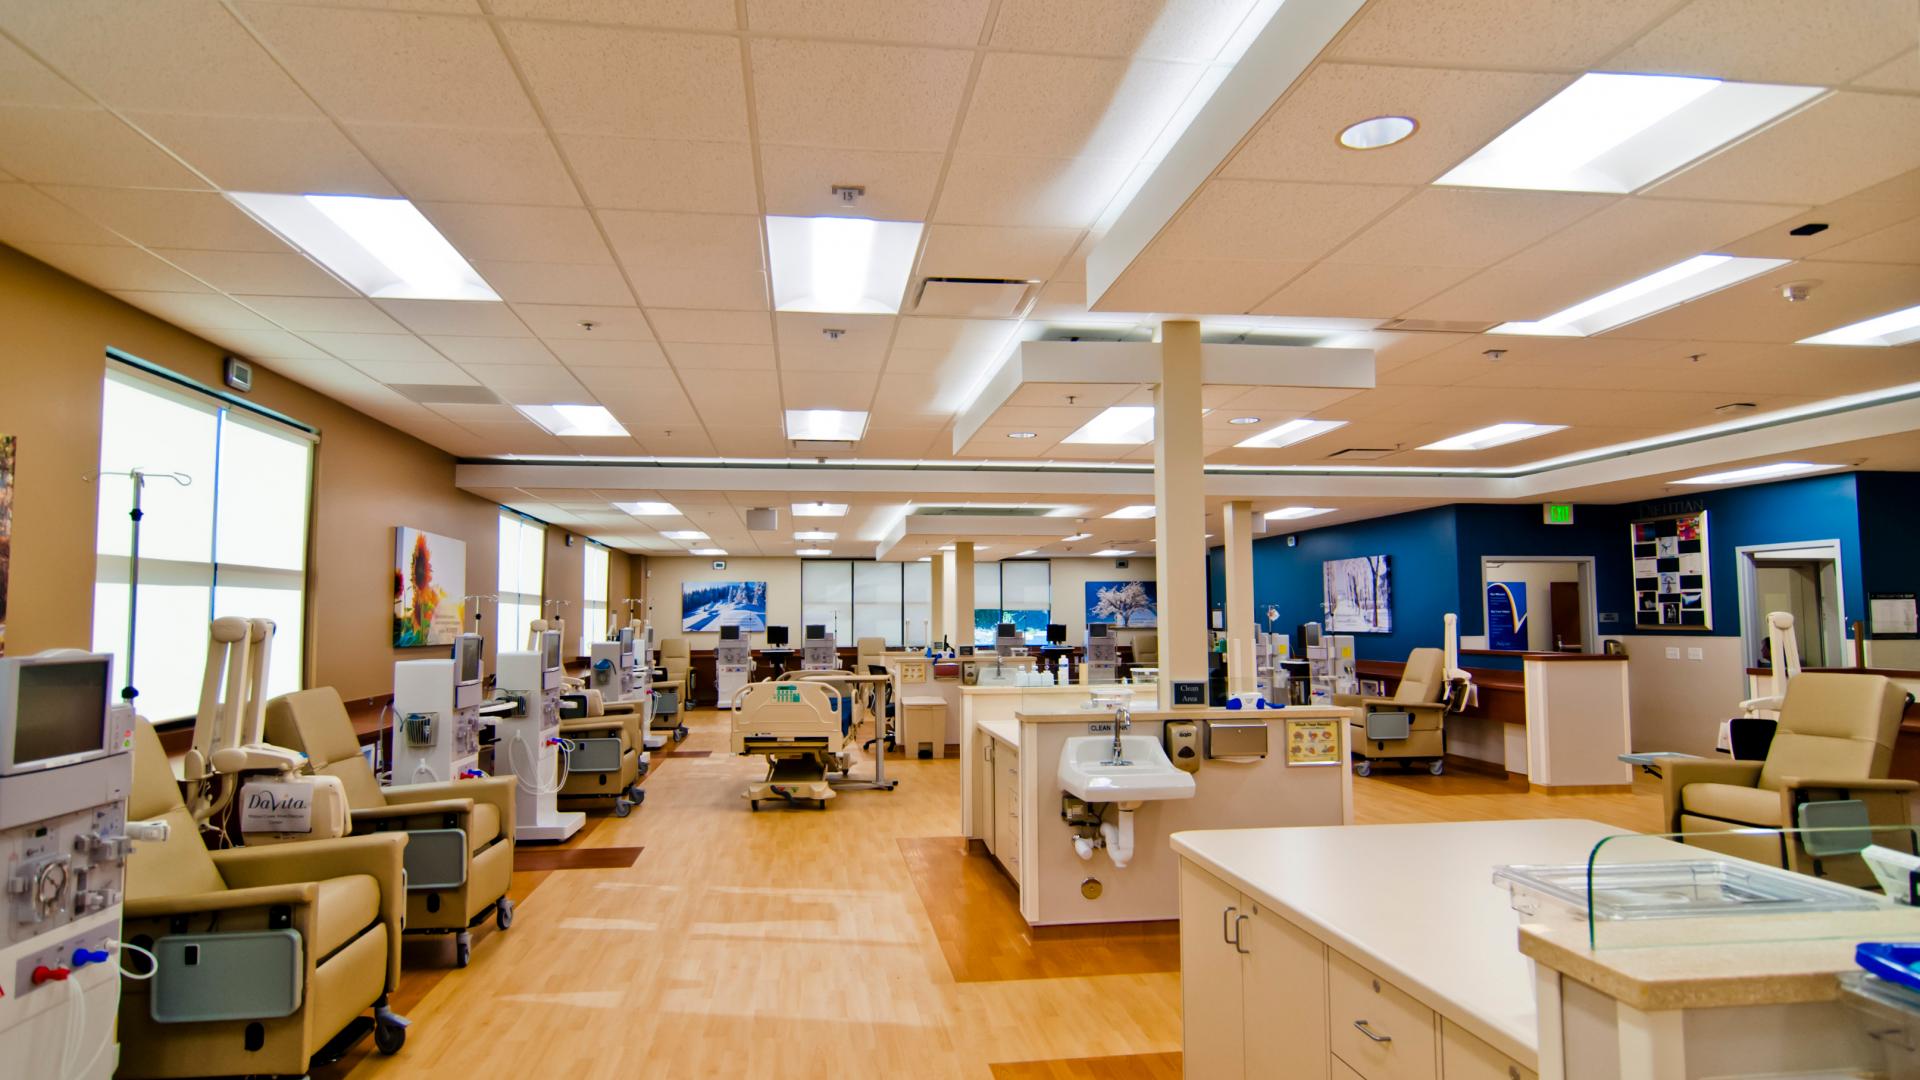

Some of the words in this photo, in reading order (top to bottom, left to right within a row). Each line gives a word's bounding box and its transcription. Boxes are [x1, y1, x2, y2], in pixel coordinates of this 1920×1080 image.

[843, 191, 854, 201] 15
[1551, 505, 1569, 522] EXIT
[1180, 684, 1199, 692] Clean
[248, 790, 304, 811] DaVita
